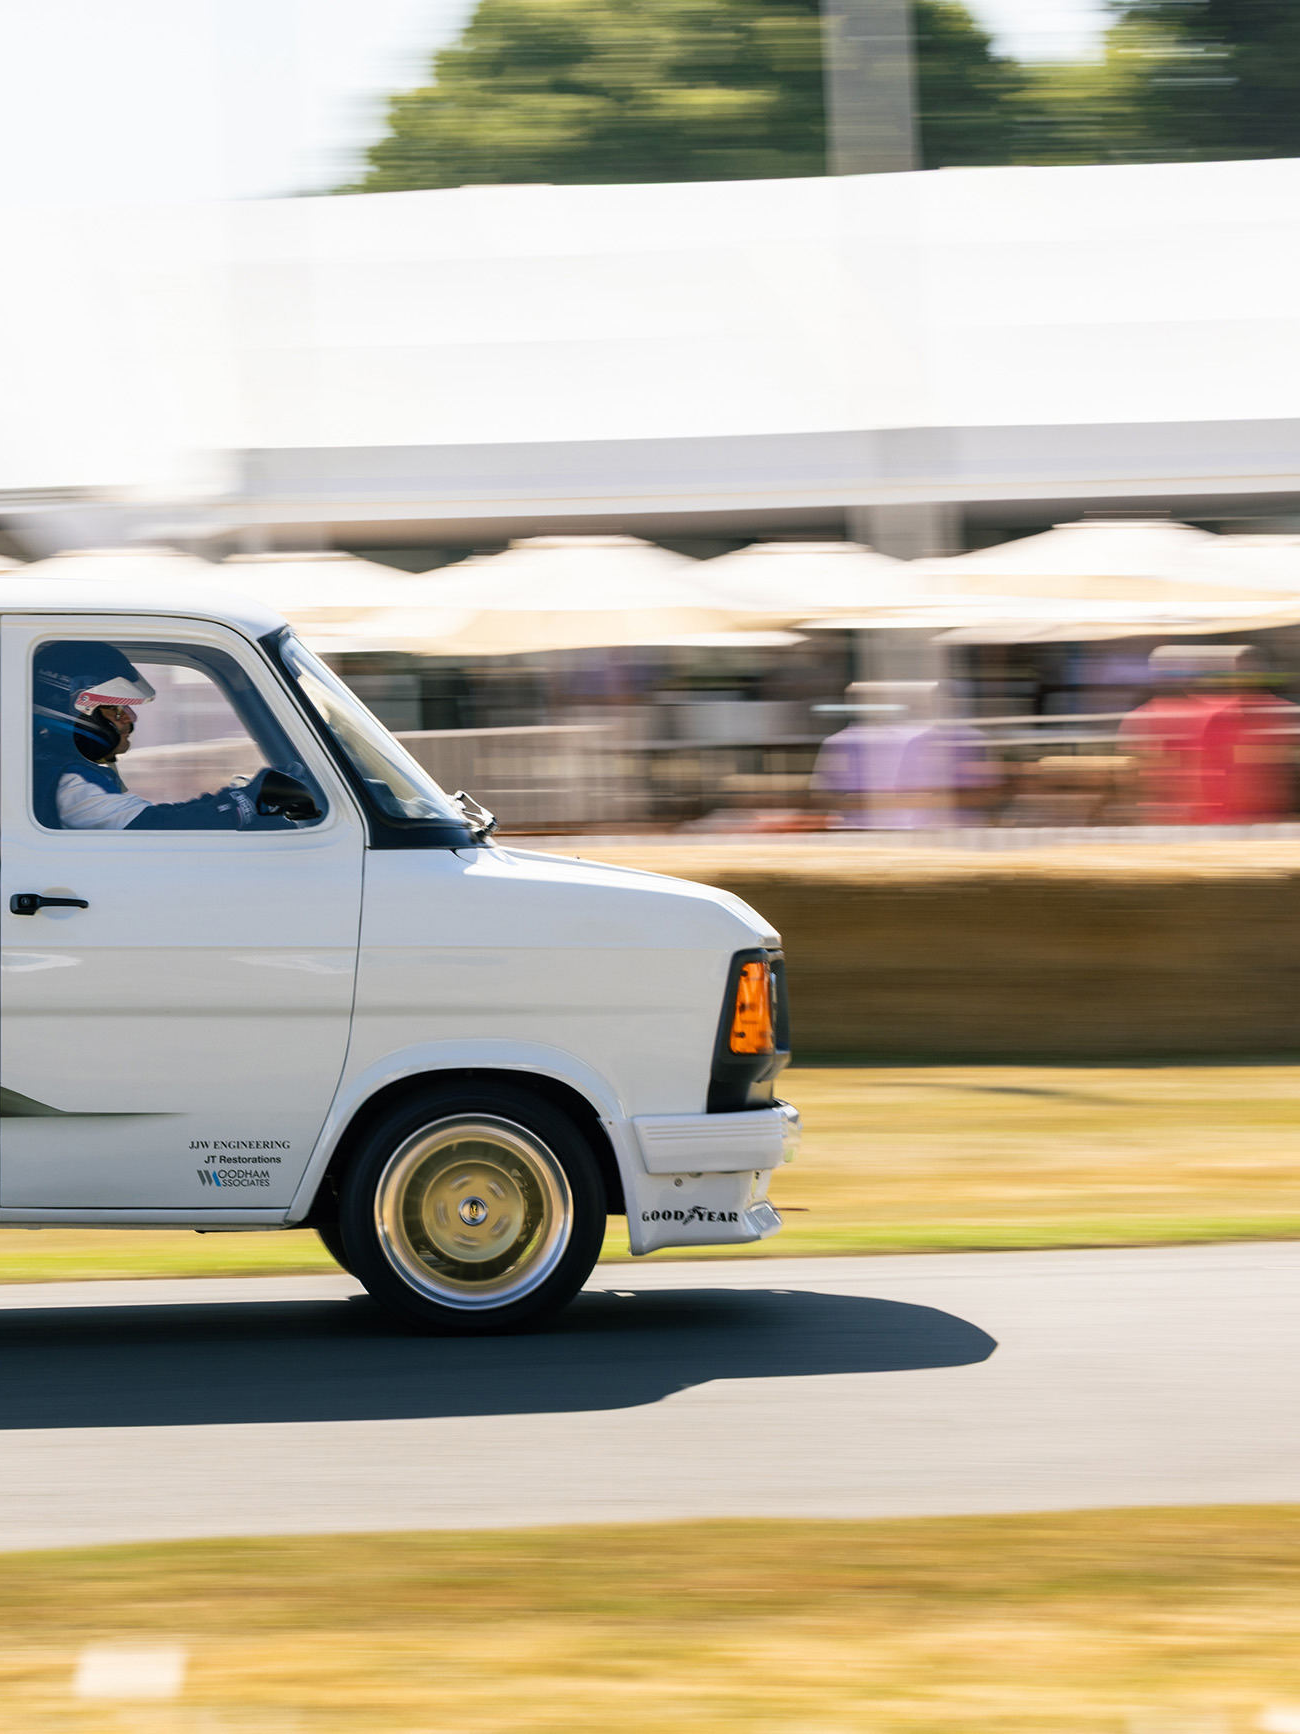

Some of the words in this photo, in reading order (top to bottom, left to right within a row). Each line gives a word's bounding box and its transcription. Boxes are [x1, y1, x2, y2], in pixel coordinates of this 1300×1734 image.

[188, 1140, 210, 1149] JJW
[213, 1140, 291, 1150] ENGINEERING
[204, 1155, 217, 1164] JT
[219, 1155, 282, 1164] Restorations
